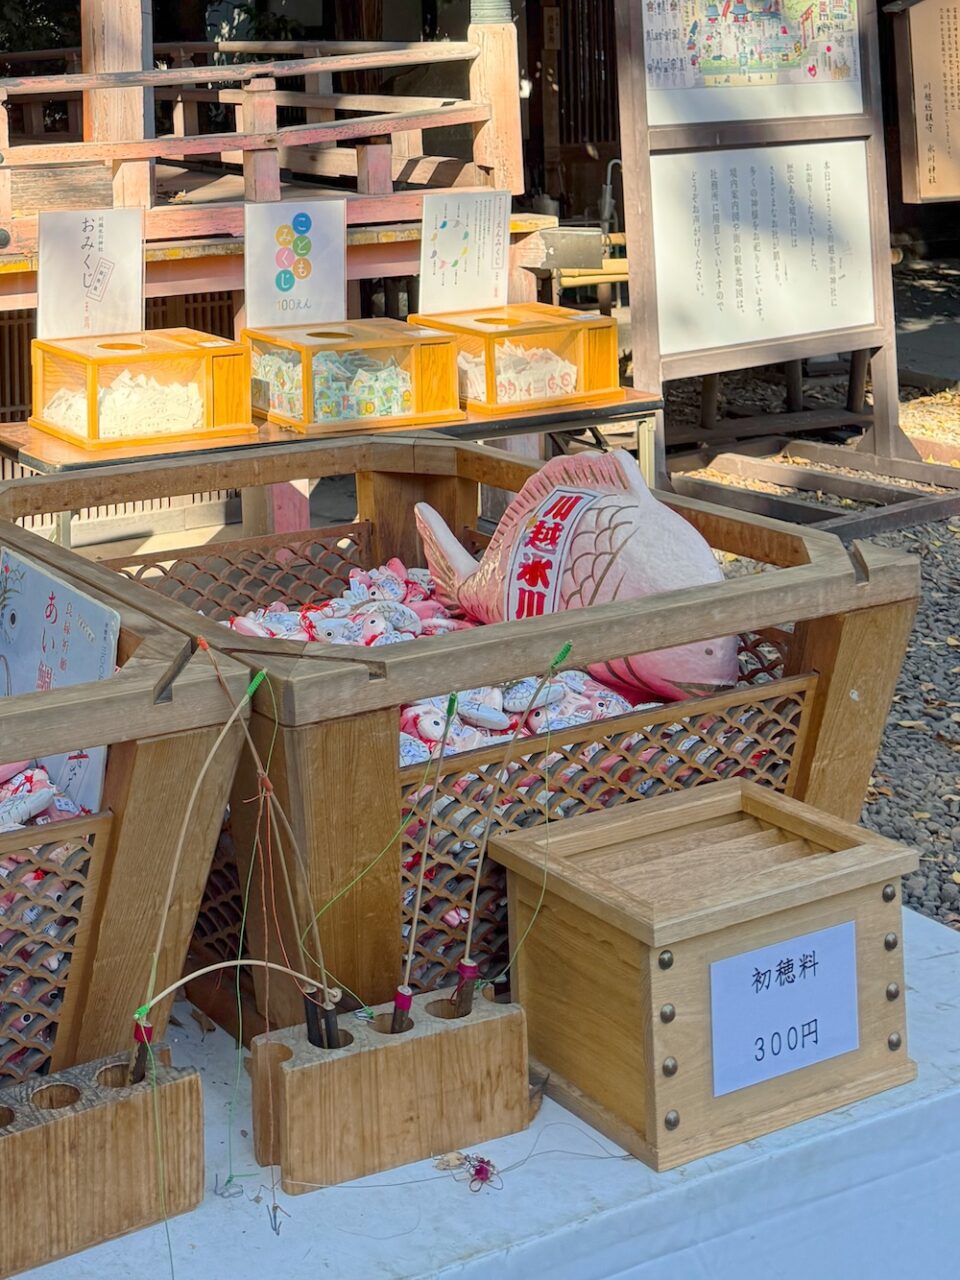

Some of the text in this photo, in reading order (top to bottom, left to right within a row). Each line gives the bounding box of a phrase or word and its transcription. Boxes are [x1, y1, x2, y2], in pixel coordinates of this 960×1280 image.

[80, 216, 95, 289] おみくじ
[276, 297, 312, 311] 100えん
[516, 495, 583, 619] 川越氷川
[751, 950, 819, 994] 初穂料
[754, 1018, 819, 1062] 300円
